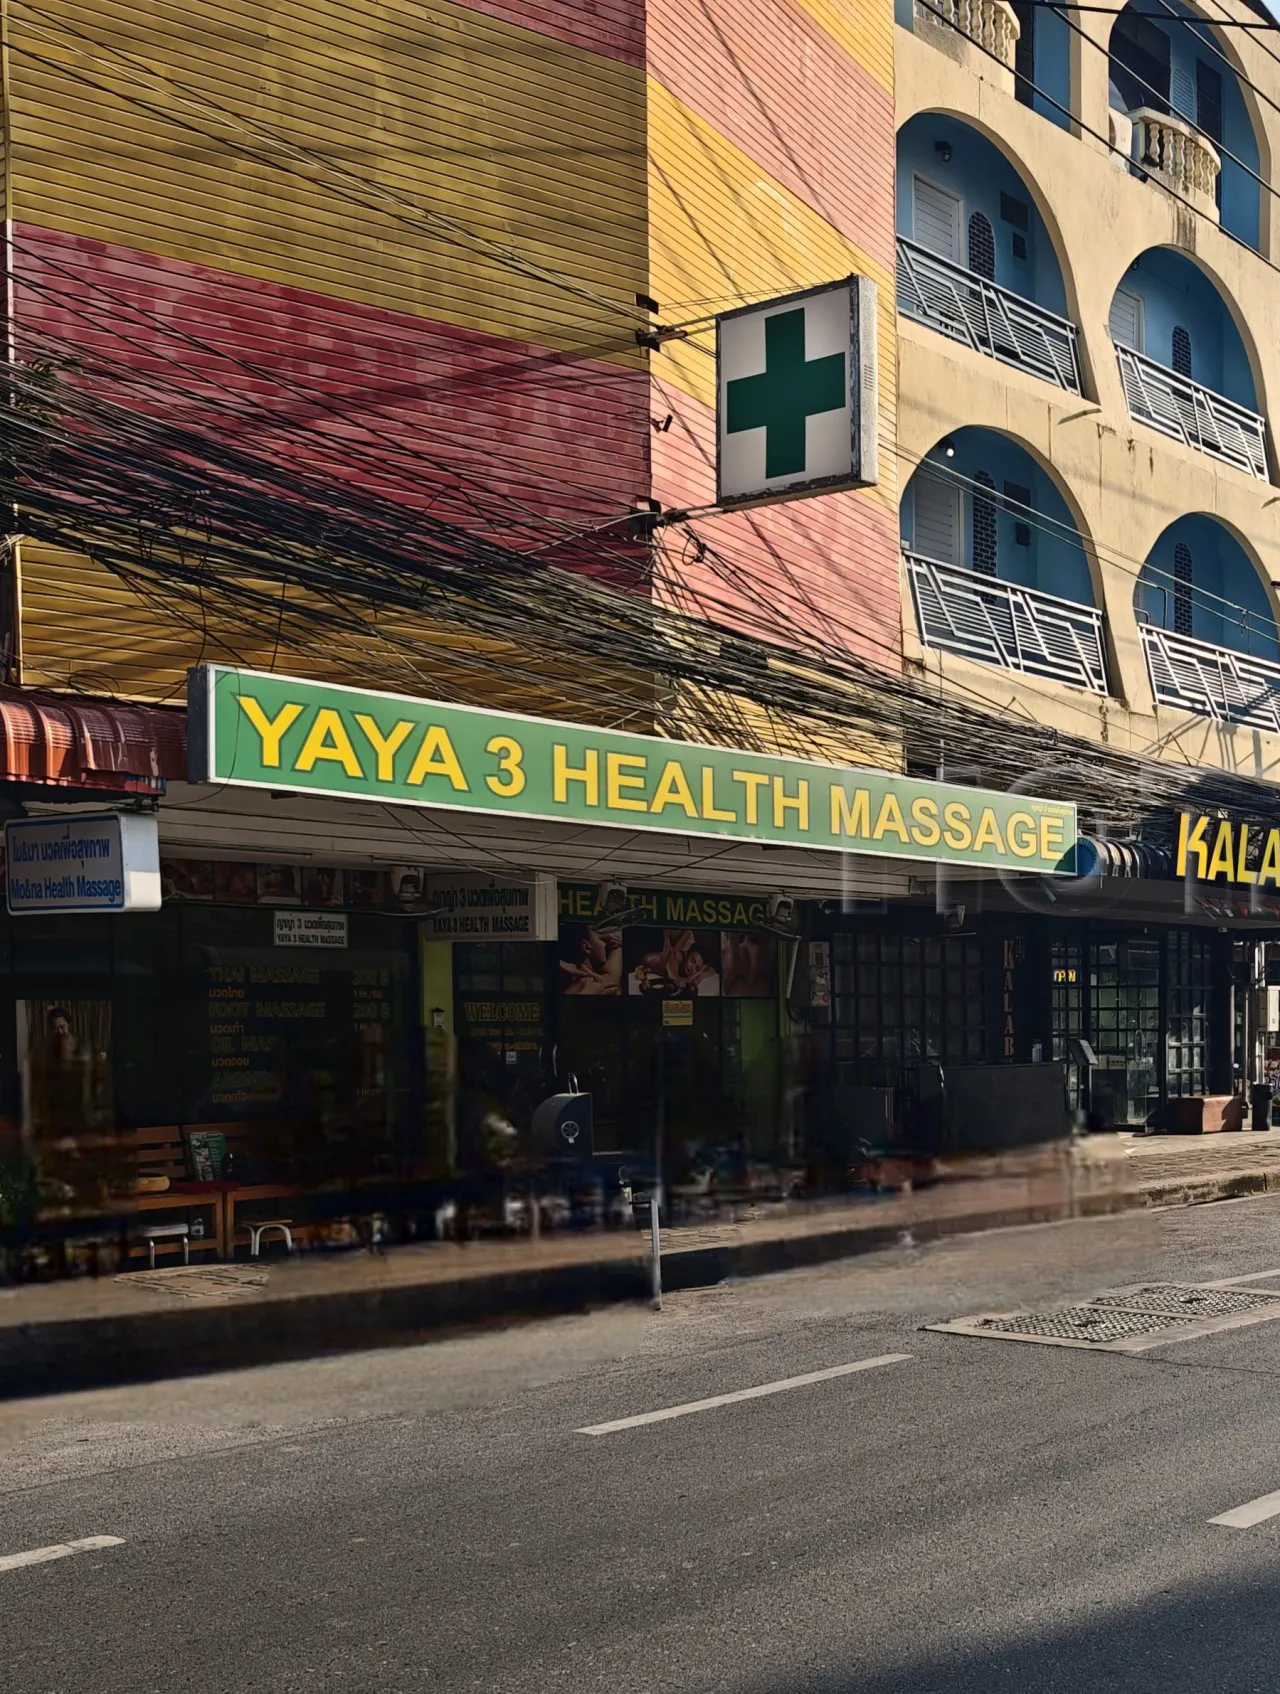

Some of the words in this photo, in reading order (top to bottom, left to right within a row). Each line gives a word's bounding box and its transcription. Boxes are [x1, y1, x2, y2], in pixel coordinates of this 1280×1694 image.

[235, 694, 470, 791] YAYA
[485, 736, 525, 797] 3
[553, 744, 809, 831] HEALTH
[830, 784, 1066, 860] MASSAGE
[11, 878, 43, 900] Mo&na
[44, 876, 75, 899] Health
[76, 875, 121, 902] Massage
[459, 888, 466, 907] 3
[666, 896, 769, 925] MASSAG
[297, 918, 302, 929] 3
[432, 915, 451, 933] YAYA
[452, 916, 458, 932] 3
[459, 915, 490, 933] HEALTH
[492, 915, 530, 933] MASSAGE
[277, 933, 292, 943] YAYA
[293, 934, 297, 943] 3
[298, 934, 319, 944] HEALTH
[320, 935, 346, 945] MASSAGE
[209, 966, 246, 984] THAI
[250, 967, 321, 985] MASSAGE
[1003, 940, 1015, 1058] KALAB
[208, 1001, 249, 1019] FOOT
[255, 1001, 327, 1019] MASSAGE
[463, 1001, 541, 1022] WELCOME
